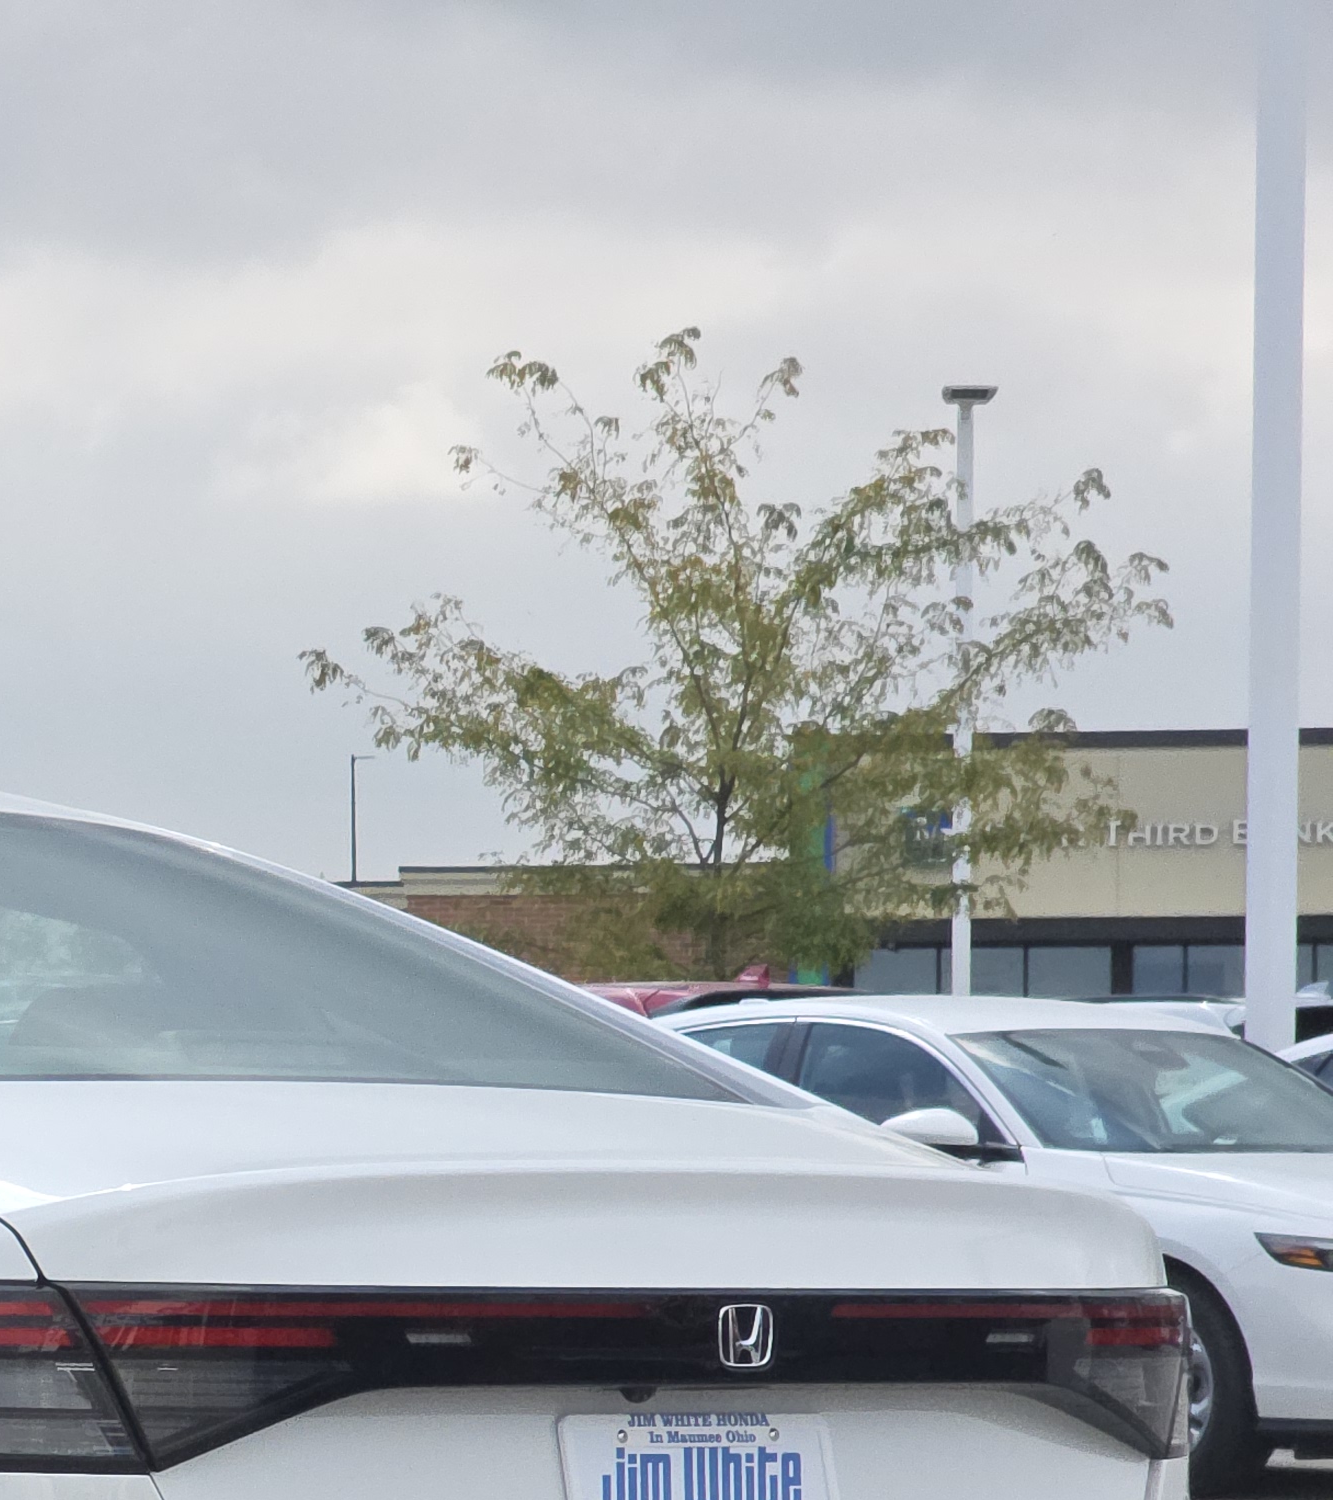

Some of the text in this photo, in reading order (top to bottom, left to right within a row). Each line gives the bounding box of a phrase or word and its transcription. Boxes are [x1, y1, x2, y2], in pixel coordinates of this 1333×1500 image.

[1107, 818, 1220, 846] THIRD
[1233, 818, 1333, 845] BNK
[627, 1412, 771, 1428] JIM WHITE HONDA
[648, 1429, 757, 1443] In Maumee Ohio
